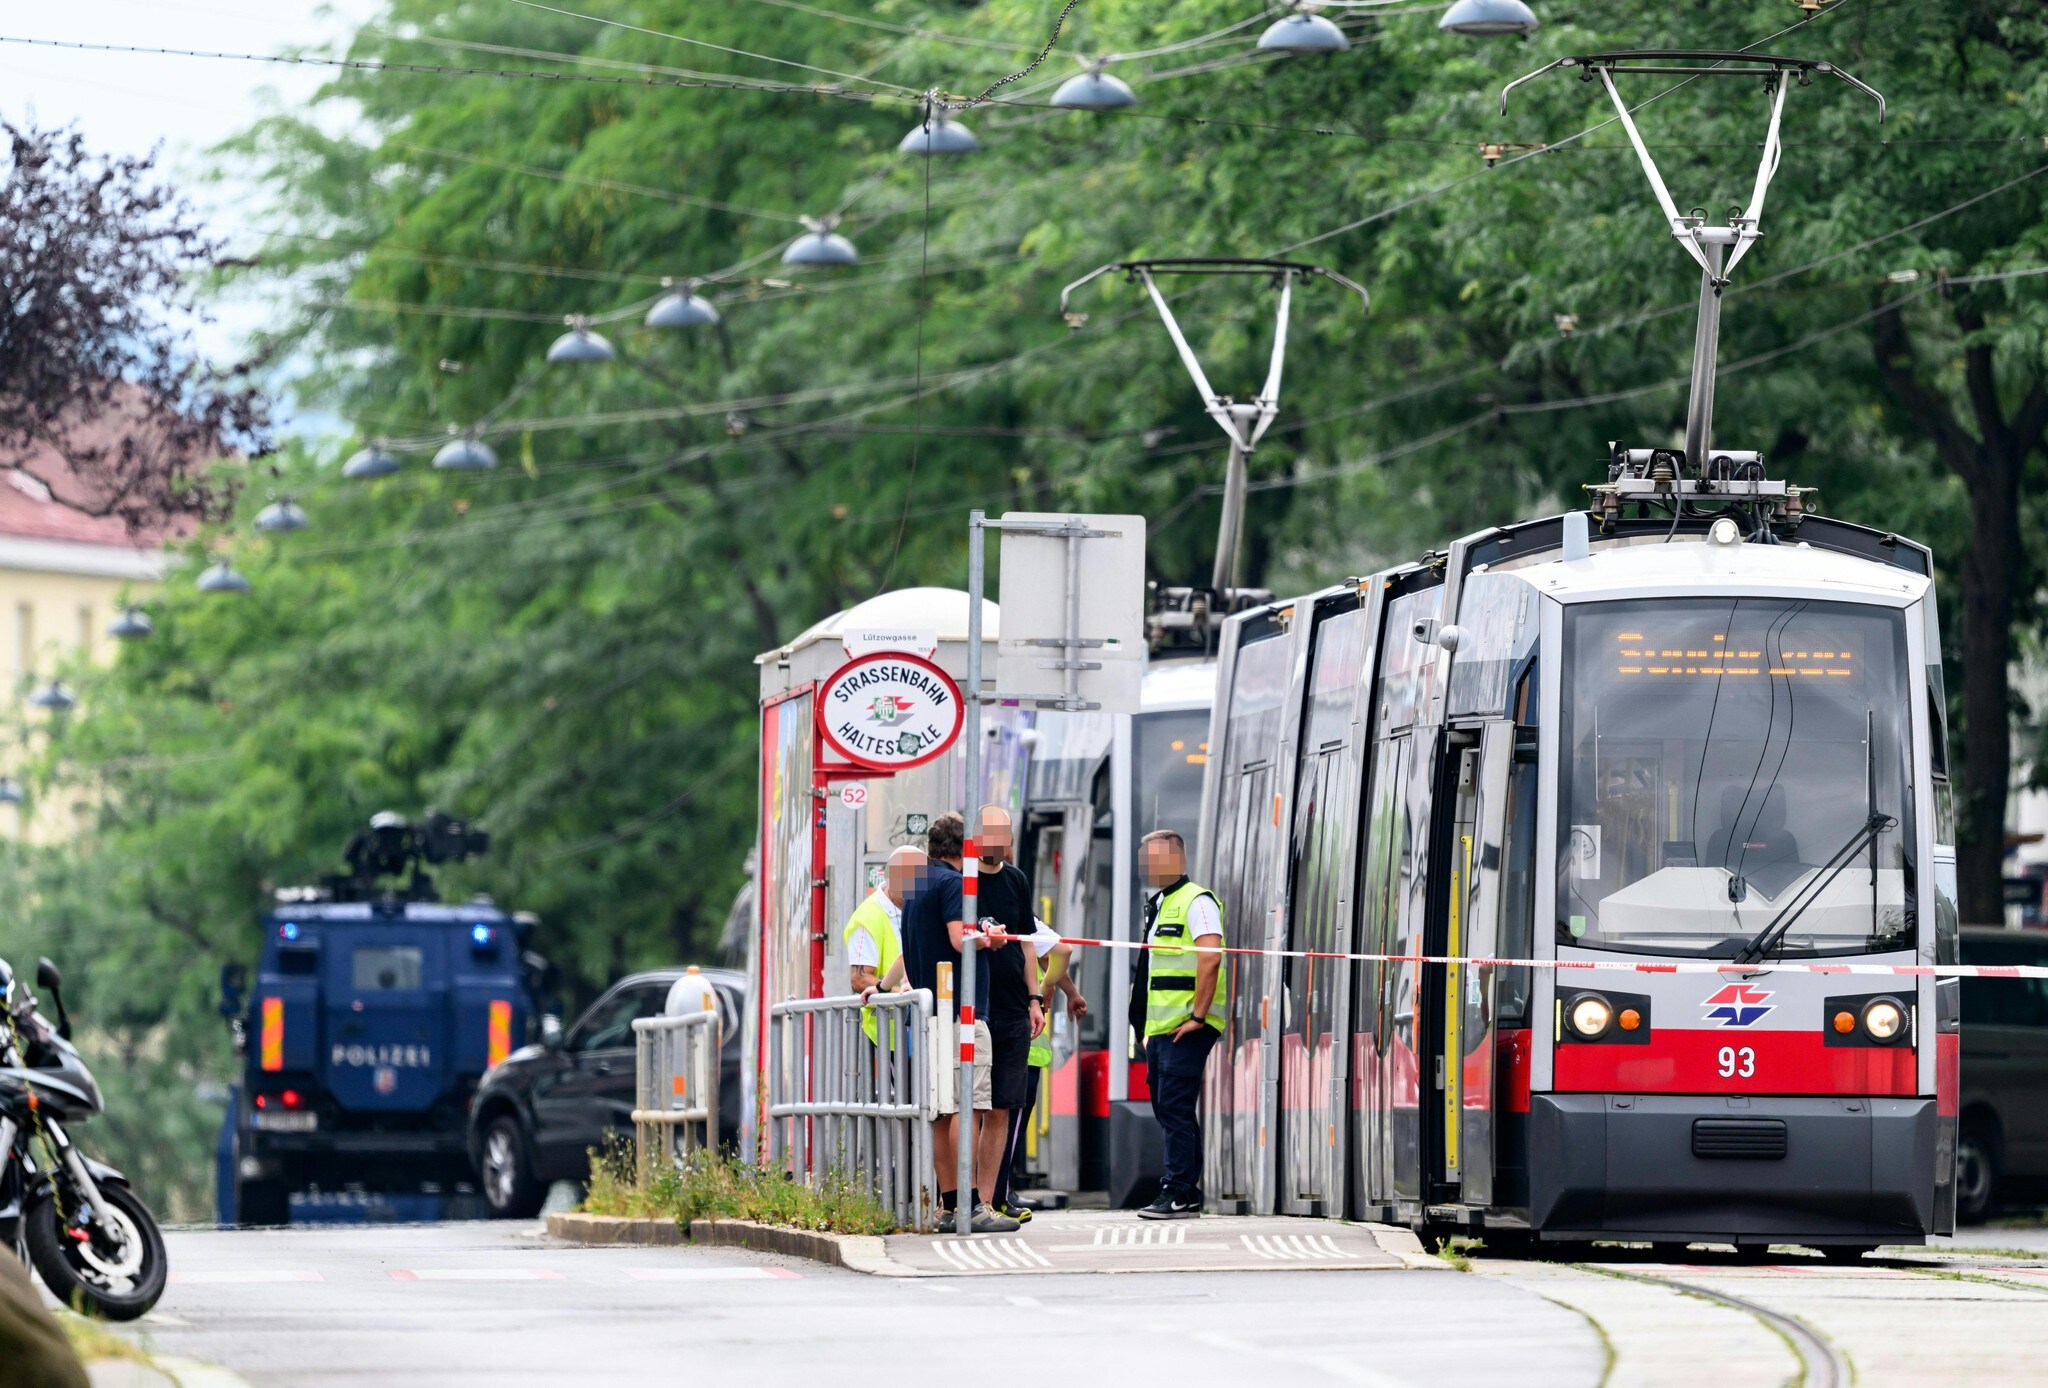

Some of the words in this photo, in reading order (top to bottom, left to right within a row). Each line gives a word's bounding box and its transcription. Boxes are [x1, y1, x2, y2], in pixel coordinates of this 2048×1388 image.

[863, 633, 917, 642] Lützowgasse
[834, 666, 948, 706] STRASSENBAHN
[838, 722, 942, 756] HALTESLLE
[844, 788, 865, 803] 52
[331, 1044, 431, 1067] POLIZEI
[1718, 1046, 1755, 1078] 93
